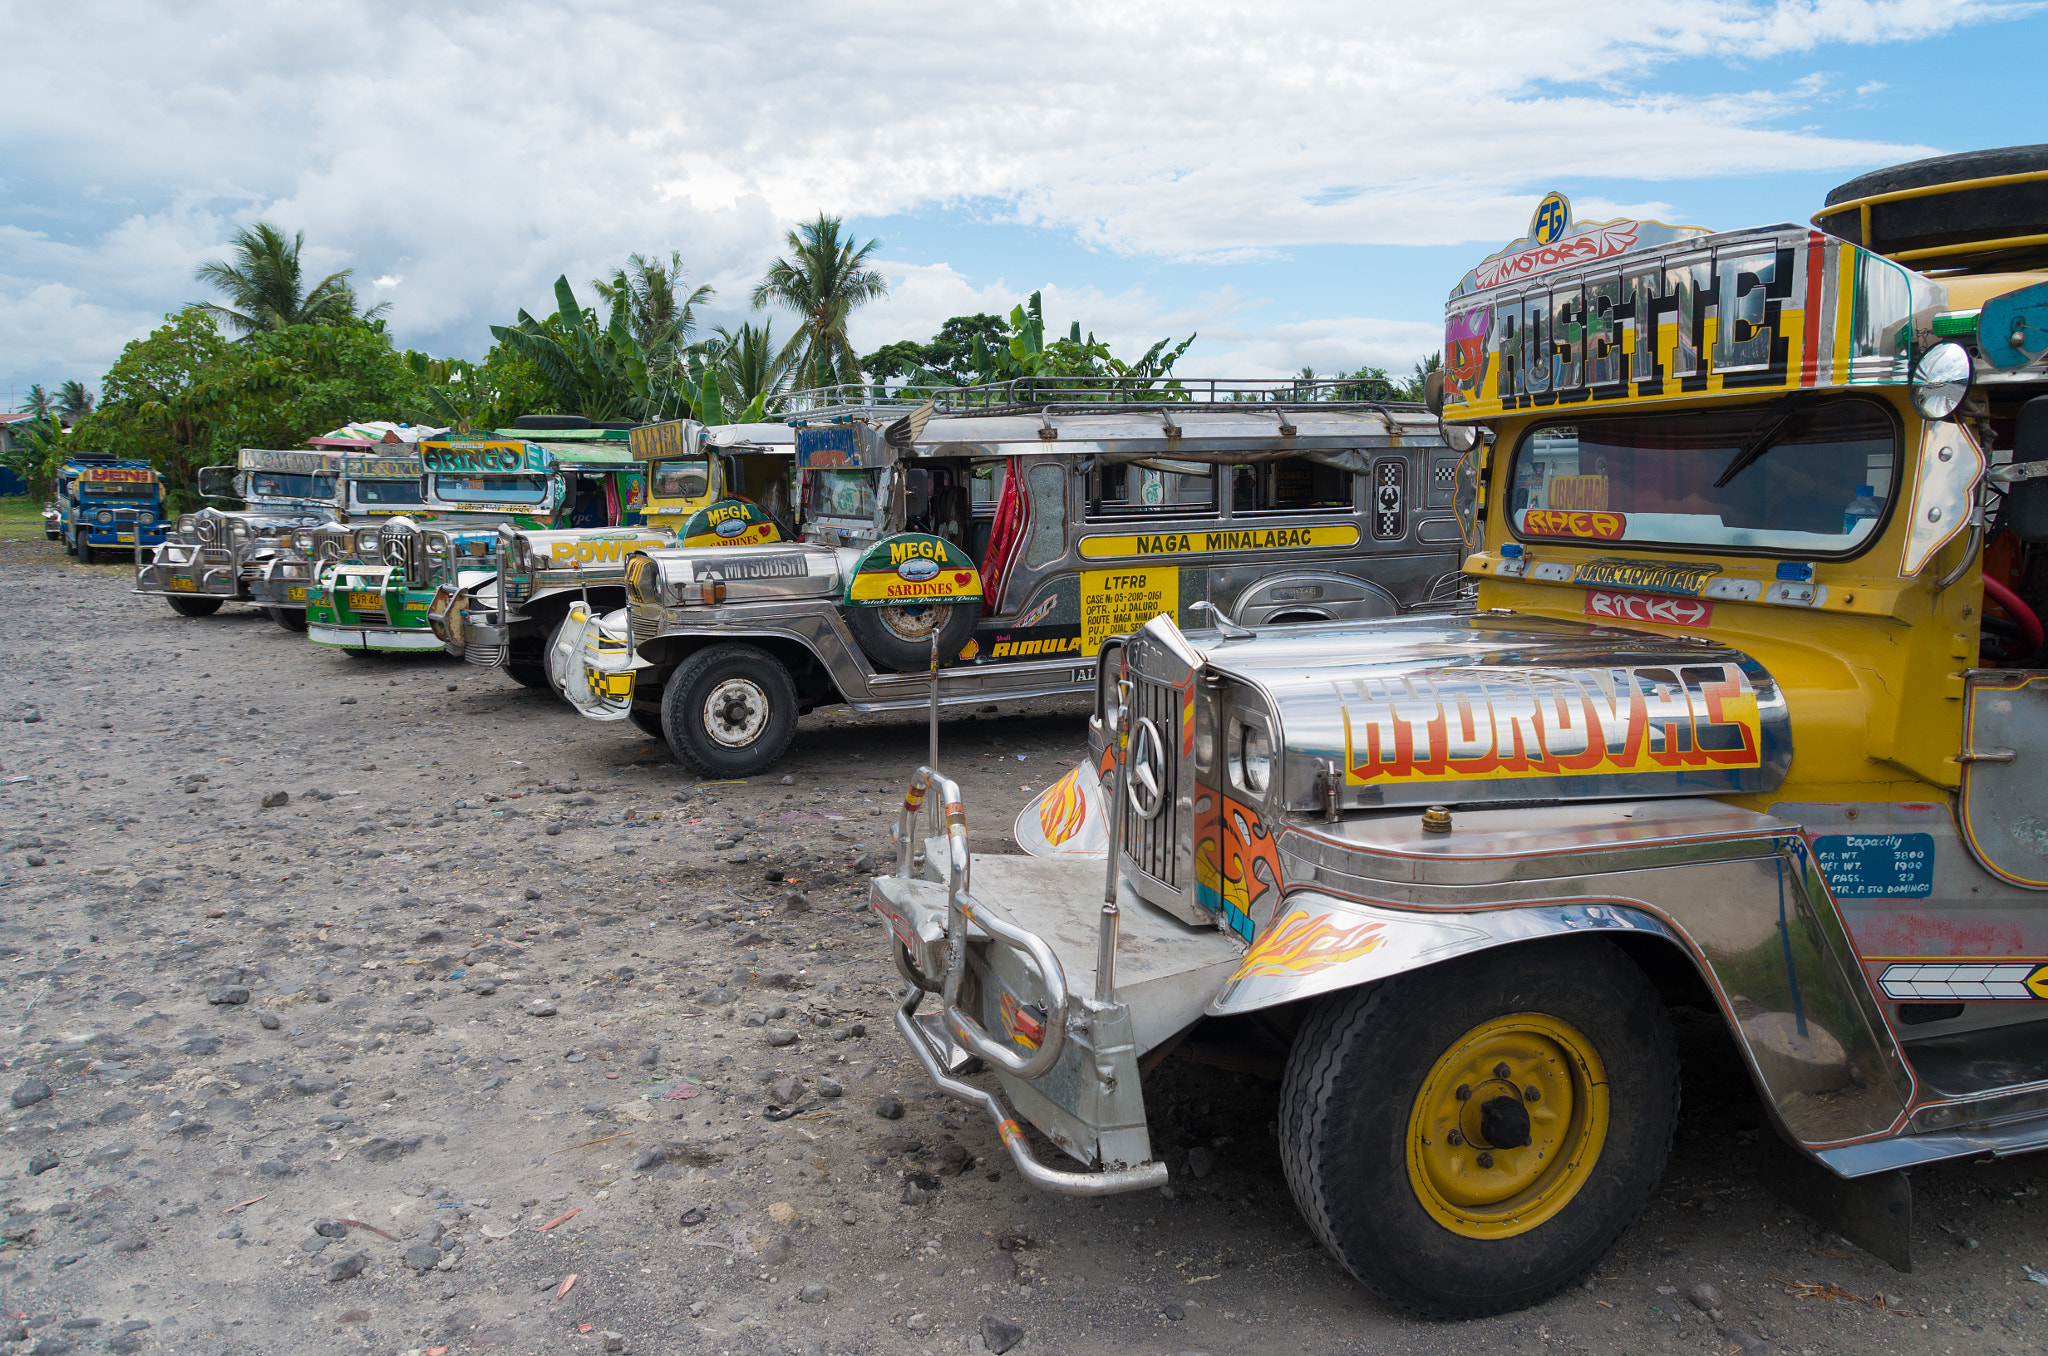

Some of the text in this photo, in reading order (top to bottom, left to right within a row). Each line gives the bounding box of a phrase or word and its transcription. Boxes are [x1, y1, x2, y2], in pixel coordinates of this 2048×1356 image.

[1535, 200, 1564, 243] FG
[1500, 237, 1598, 279] MOTORS
[1496, 238, 1790, 408] ROSETTE
[1548, 478, 1608, 512] LIBMANAN
[706, 504, 752, 527] MEGA
[1526, 511, 1619, 538] RHEA
[578, 533, 638, 541] SPEED
[1137, 529, 1311, 554] NAGA MINALABAC
[889, 541, 948, 565] MEGA
[724, 557, 807, 579] MITSUBISHI
[887, 583, 952, 597] SARDINES
[1105, 575, 1146, 590] LTFRB
[350, 593, 368, 605] EVR
[1086, 594, 1104, 605] CASE
[1114, 591, 1162, 603] 05-2010-0161
[1086, 601, 1158, 615] OPTR. J J DALURO
[1591, 592, 1706, 624] RICKY
[1088, 610, 1174, 625] ROUTE NAGA MINALAC
[1088, 622, 1146, 635] PUJ DUAL SER
[996, 634, 1011, 642] Shell
[992, 636, 1081, 658] RIMULA
[1333, 662, 1760, 779] HYDROVAC
[1847, 836, 1902, 850] Capacity
[1894, 851, 1924, 860] 3800
[1894, 861, 1922, 871] 1900
[1832, 874, 1864, 883] PASS.
[1888, 883, 1930, 894] DOMINGO
